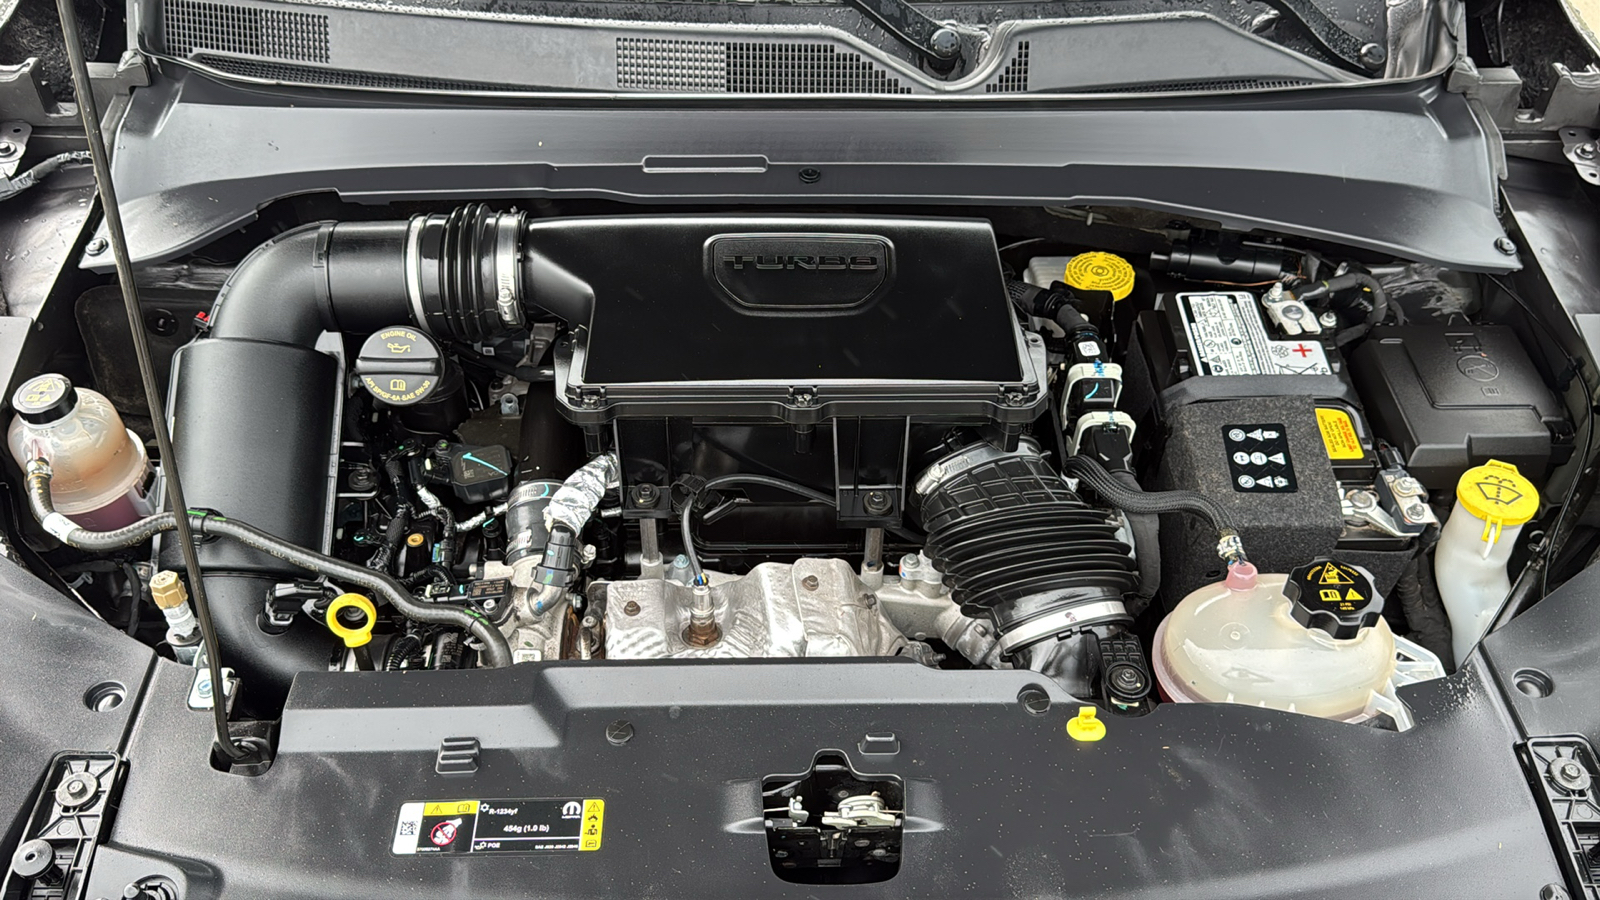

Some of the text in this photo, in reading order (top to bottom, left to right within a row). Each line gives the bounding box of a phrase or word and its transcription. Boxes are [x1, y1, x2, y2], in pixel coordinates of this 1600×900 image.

[723, 255, 878, 270] TURBO
[380, 330, 417, 341] ENGINE OIL
[401, 392, 416, 401] SAE
[488, 808, 518, 816] R-1234yf
[503, 824, 550, 833] 454g (1.0 lb)
